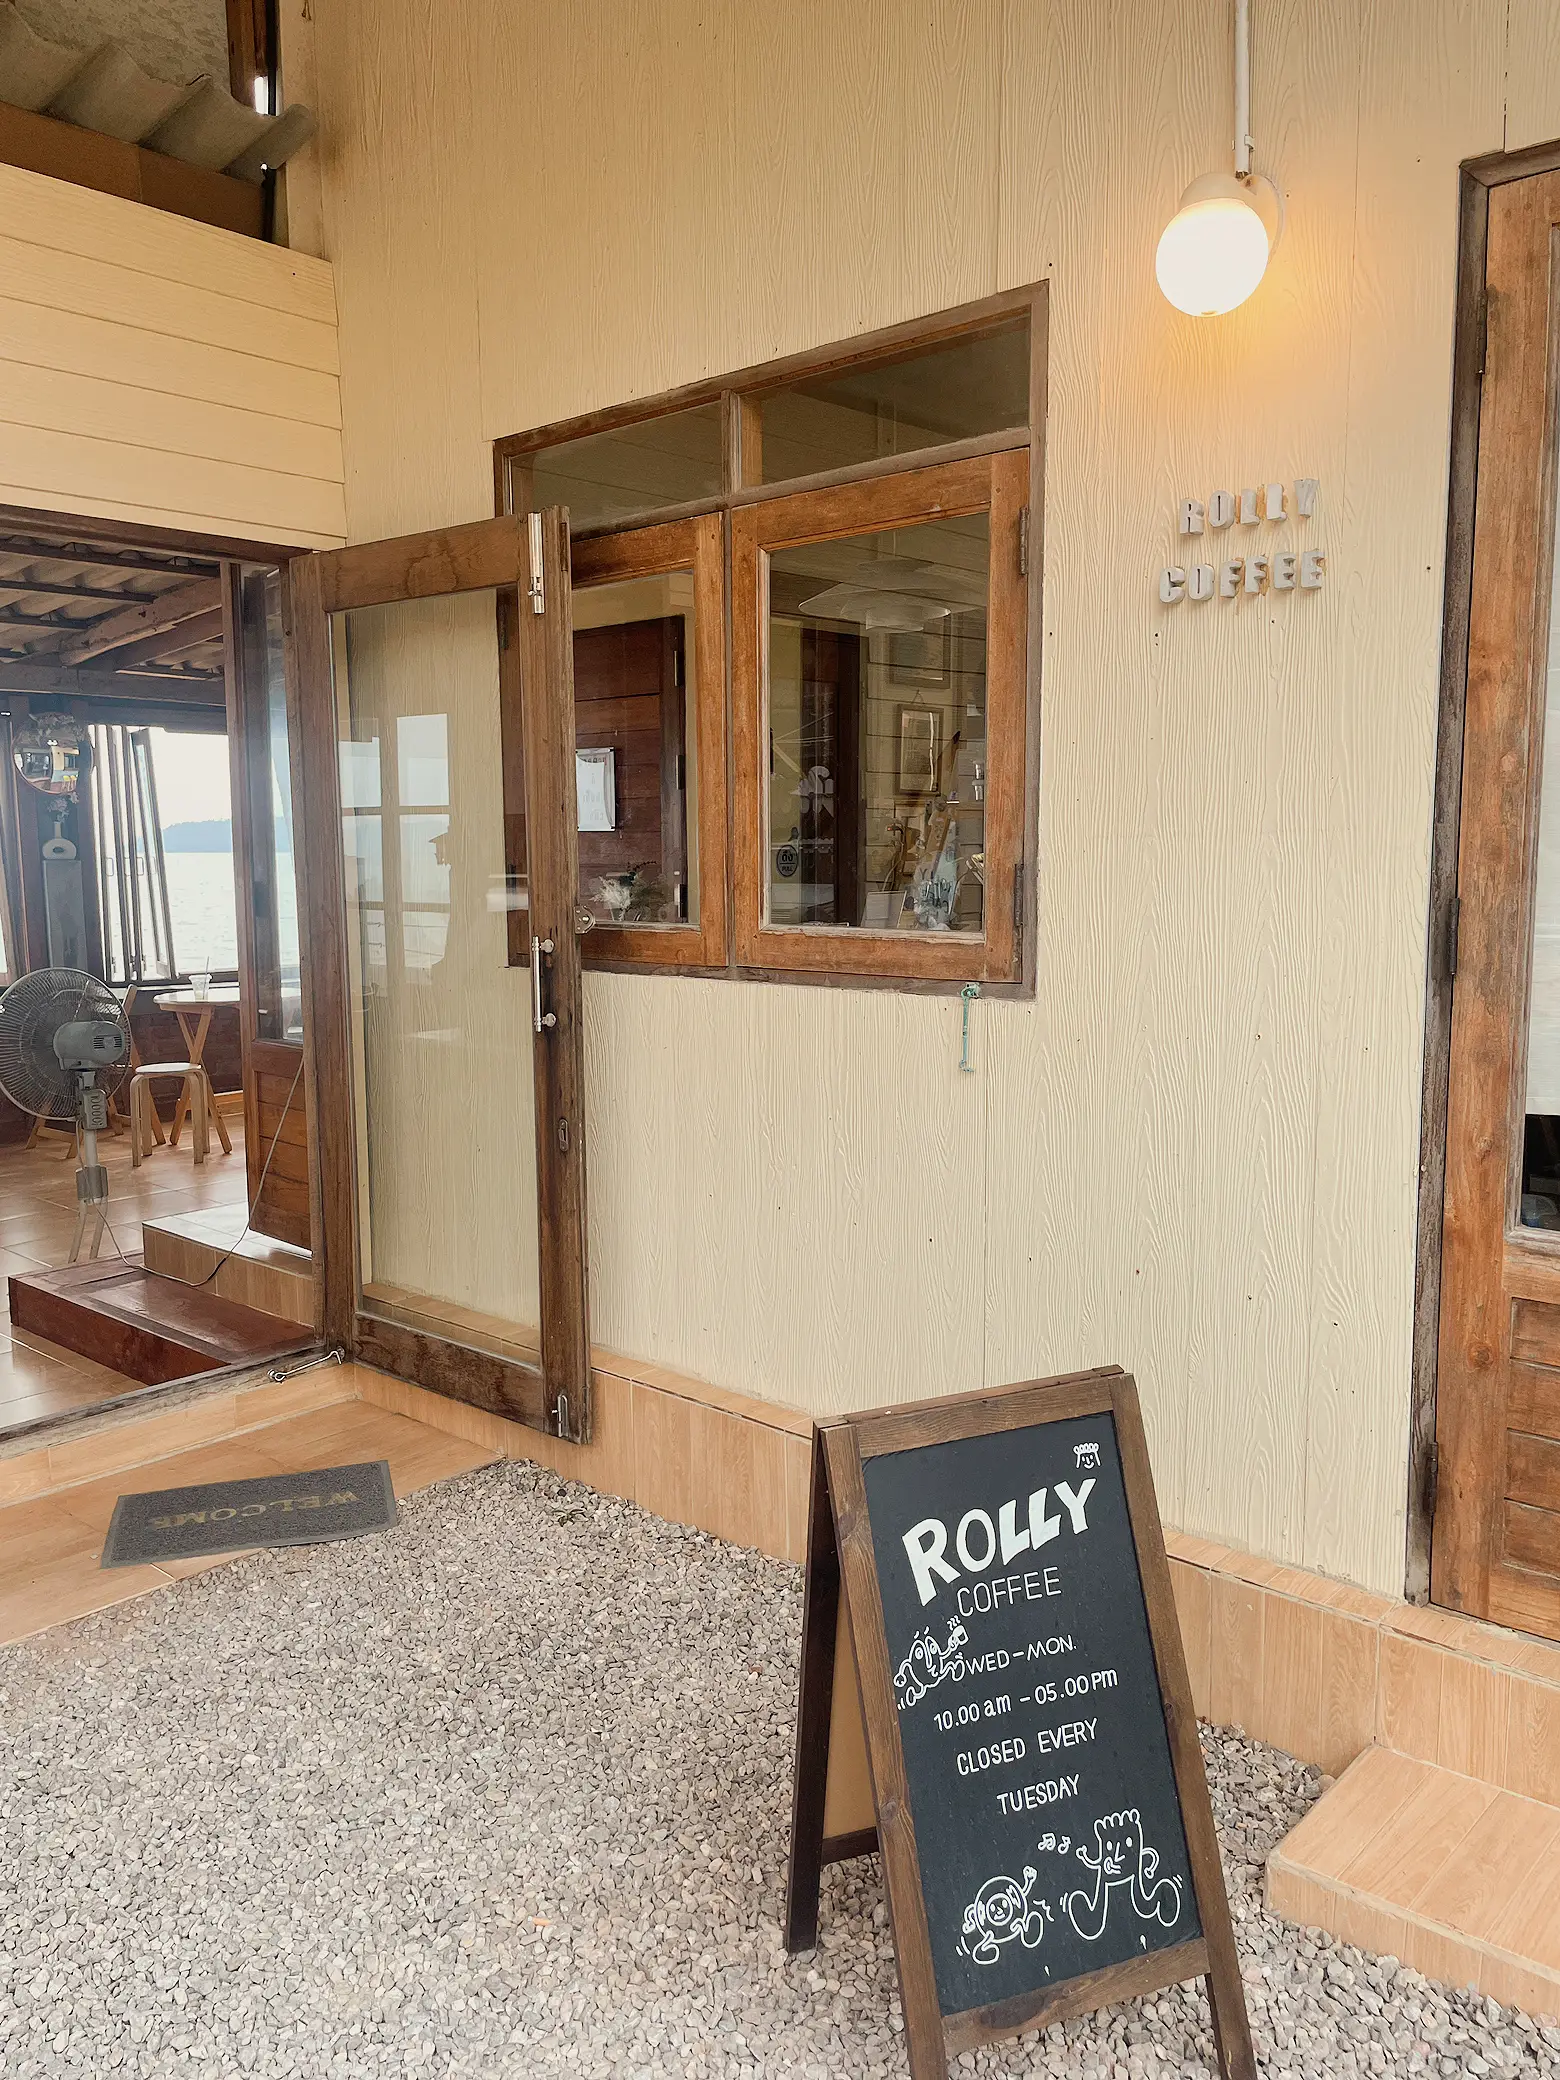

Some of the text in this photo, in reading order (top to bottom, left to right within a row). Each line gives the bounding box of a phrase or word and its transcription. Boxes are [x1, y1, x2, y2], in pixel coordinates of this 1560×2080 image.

[1179, 477, 1320, 536] ROLLY
[1159, 548, 1325, 604] COFFEE
[153, 1491, 358, 1530] WELCOME
[902, 1478, 1097, 1607] ROLLY
[956, 1566, 1062, 1617] COFFEE
[933, 1703, 980, 1732] 10.00
[983, 1694, 1012, 1717] am
[956, 1718, 1098, 1776] CLOSED EVERY
[996, 1773, 1080, 1815] TUESDAY
